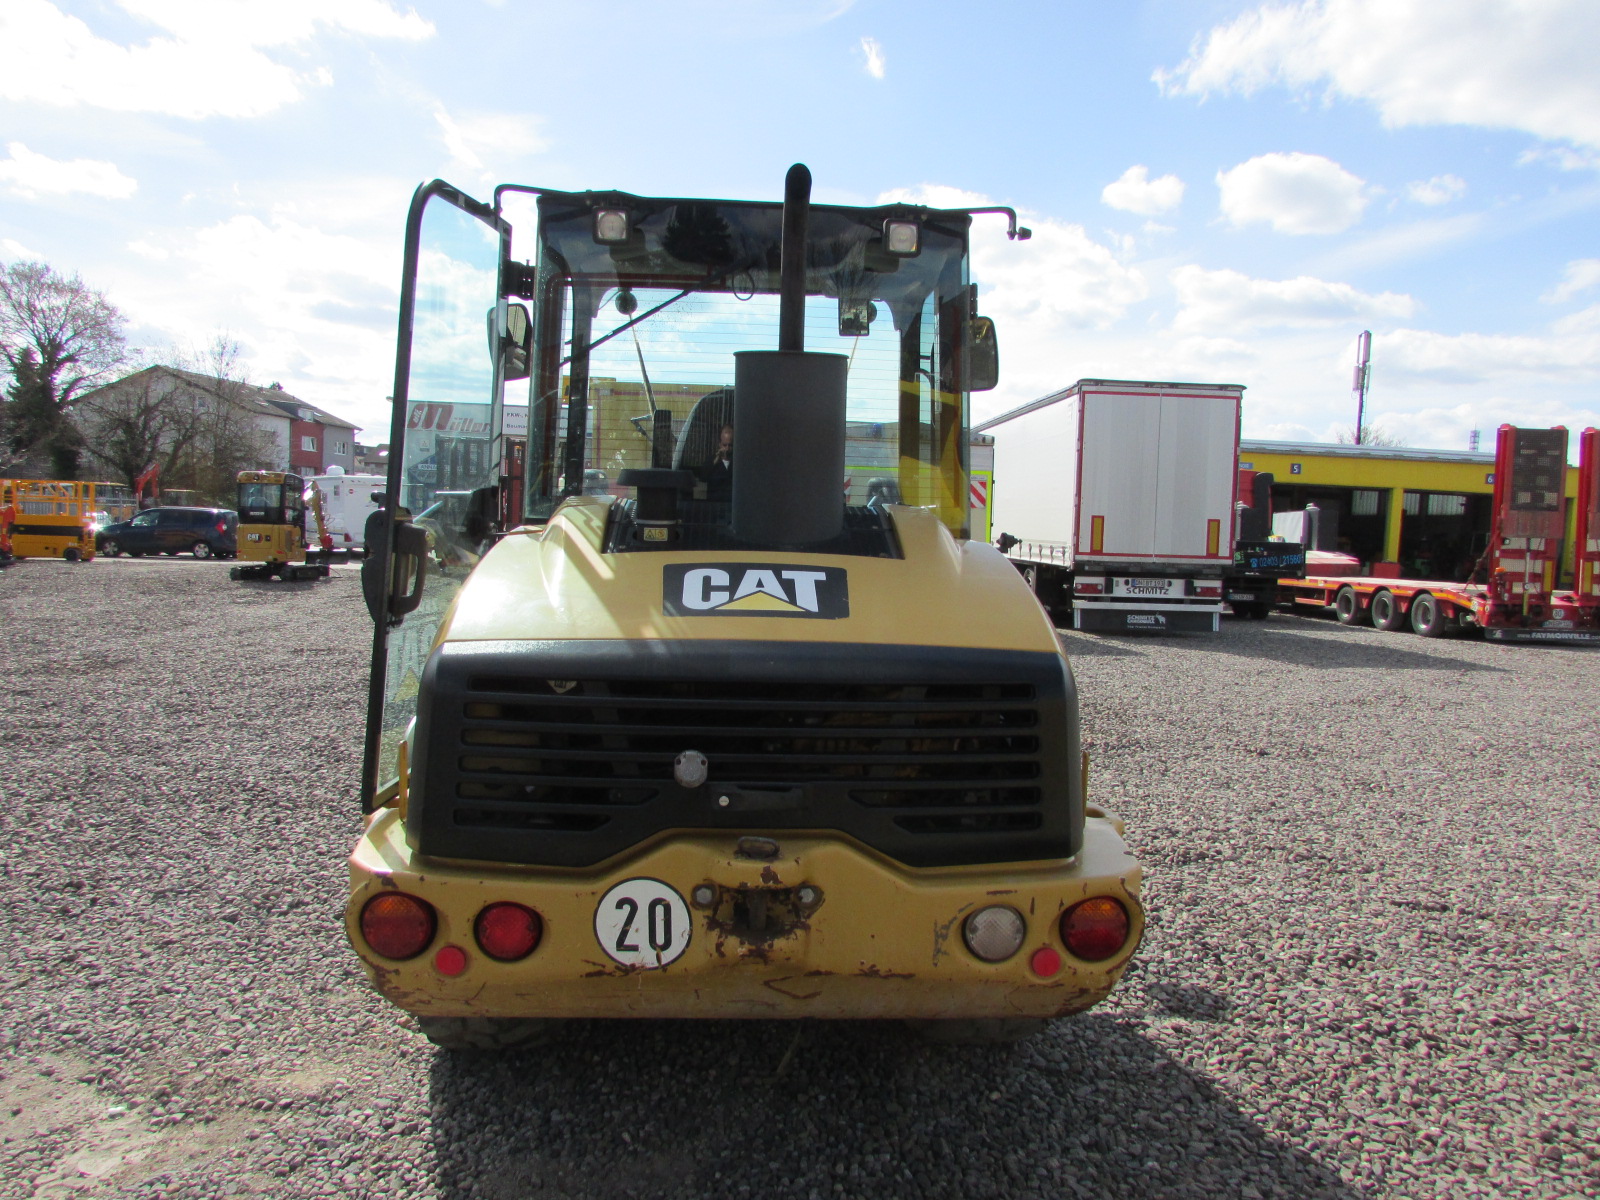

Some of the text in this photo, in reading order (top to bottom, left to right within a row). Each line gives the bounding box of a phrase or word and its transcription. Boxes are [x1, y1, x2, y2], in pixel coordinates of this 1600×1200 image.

[1293, 464, 1299, 474] 5
[1487, 475, 1493, 484] 6
[247, 533, 260, 541] CAT
[682, 568, 827, 613] CAT
[1126, 586, 1170, 596] SCHMITZ
[615, 896, 672, 952] 20
